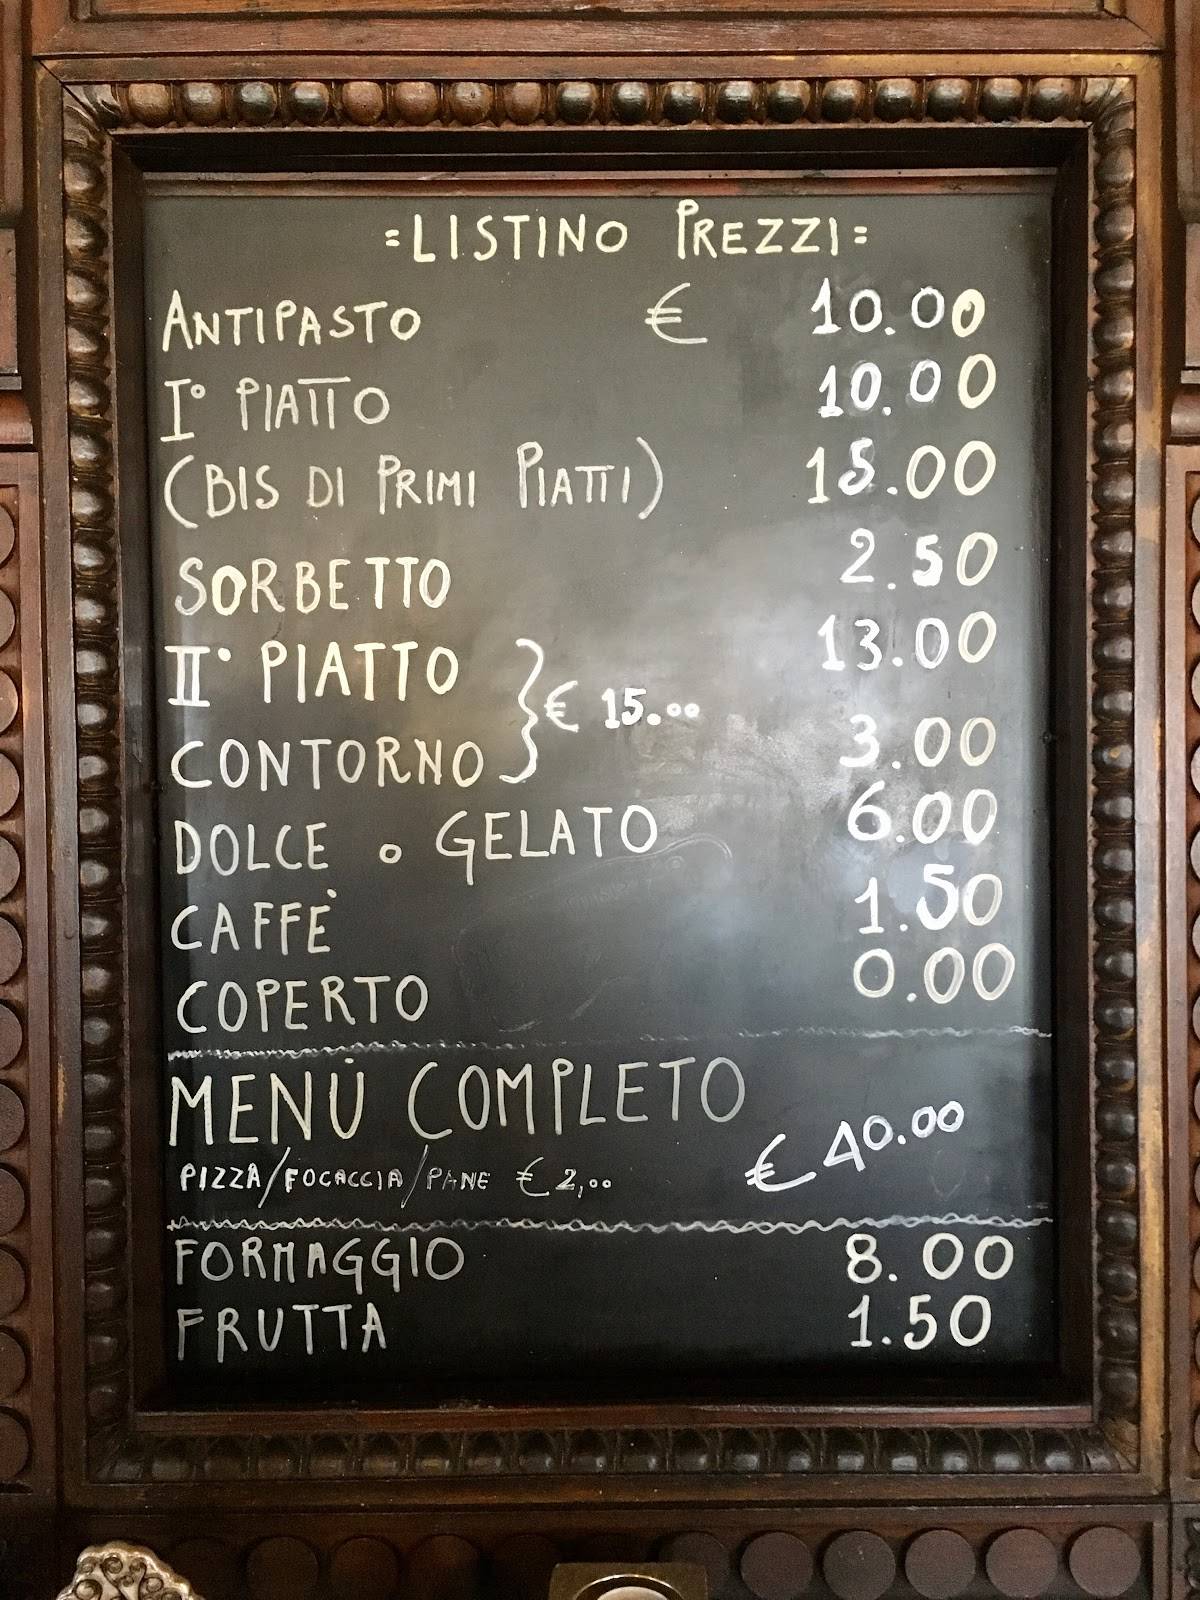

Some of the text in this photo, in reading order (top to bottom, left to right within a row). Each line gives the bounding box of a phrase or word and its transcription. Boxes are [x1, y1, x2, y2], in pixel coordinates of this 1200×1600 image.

[163, 278, 986, 352] ANTIPASTO € 10.00
[236, 376, 390, 432] PIATTO
[818, 353, 996, 418] 10.00
[164, 437, 997, 528] (BIS DI PRIMI PIATTI) 15.00
[175, 528, 998, 615] SORBETTO 2.50
[261, 640, 459, 704] PIATTO
[818, 611, 997, 671] 13.00
[544, 681, 700, 732] € 15.00
[170, 714, 997, 792] CONTORNO 3.00
[175, 820, 329, 876] DOLCE
[435, 804, 658, 886] GELATO
[848, 780, 998, 845] 6.00
[854, 863, 1003, 935] 1.50
[177, 943, 1015, 1034] COPERTO 0.00
[407, 1056, 745, 1140] COMPLETO
[516, 1156, 550, 1197] €
[744, 1100, 965, 1192] € 40.00
[175, 1233, 1014, 1295] FORMAGGIO 8.00
[177, 1294, 992, 1364] FRUTTA 1.50
